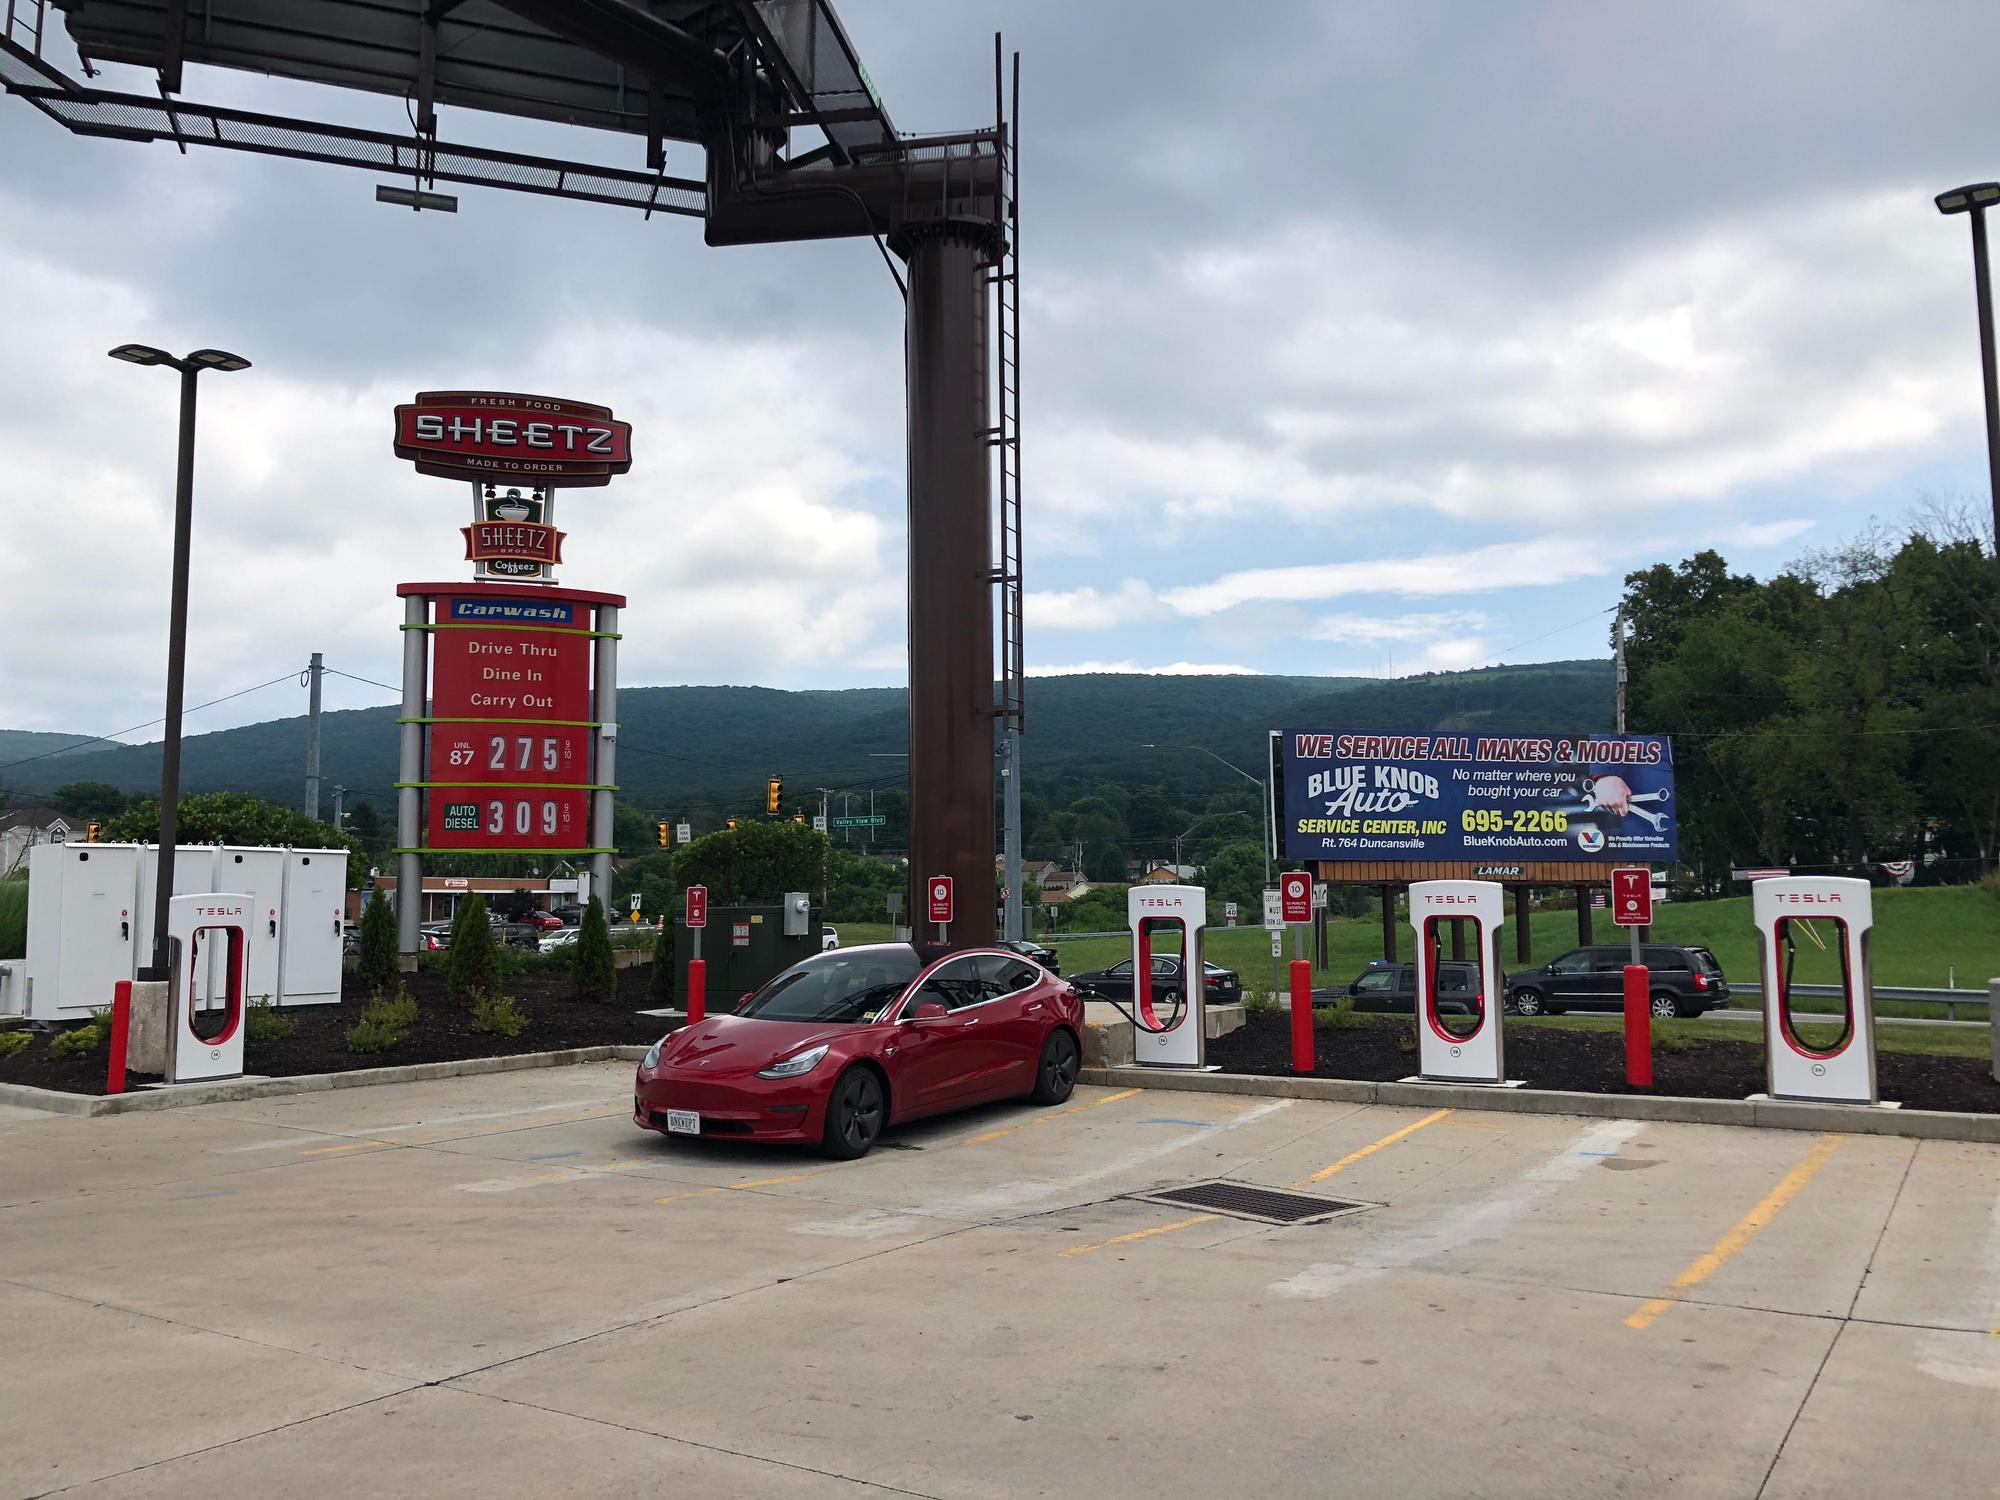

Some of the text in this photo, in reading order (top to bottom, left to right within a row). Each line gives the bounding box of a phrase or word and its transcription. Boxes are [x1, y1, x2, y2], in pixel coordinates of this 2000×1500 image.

[471, 398, 561, 411] FRESH FOOD
[416, 414, 612, 454] SHEETZ
[467, 458, 563, 472] MADE TO ORDER
[482, 527, 548, 550] SHEETZ
[495, 560, 535, 574] Coffeez
[458, 603, 567, 619] Carwash
[468, 641, 558, 656] Drive Thru
[483, 668, 542, 682] Dine In
[470, 693, 553, 708] Carry Out
[565, 740, 570, 748] 9
[1296, 734, 1662, 764] WE SERVICE ALL MAKES & MODELS
[450, 750, 474, 765] 87
[564, 750, 572, 759] 10
[1308, 766, 1440, 799] BLUE KNOB
[1452, 769, 1576, 784] No matter where you
[1468, 784, 1562, 799] bought your car
[564, 803, 569, 812] 9
[1324, 786, 1419, 817] Auto
[449, 806, 476, 816] AUTO
[445, 818, 478, 829] DIESEL
[562, 814, 570, 823] 10
[1462, 809, 1568, 832] 695-2266
[1298, 819, 1360, 834] SERVICE
[1322, 838, 1424, 848] Rt. 764 Duncansville
[1463, 836, 1568, 846] BlueKnobAuto.com
[1477, 867, 1519, 875] LAMAR
[1425, 895, 1477, 904] TESLA
[1775, 894, 1841, 903] TESLA
[196, 907, 242, 915] TESLA
